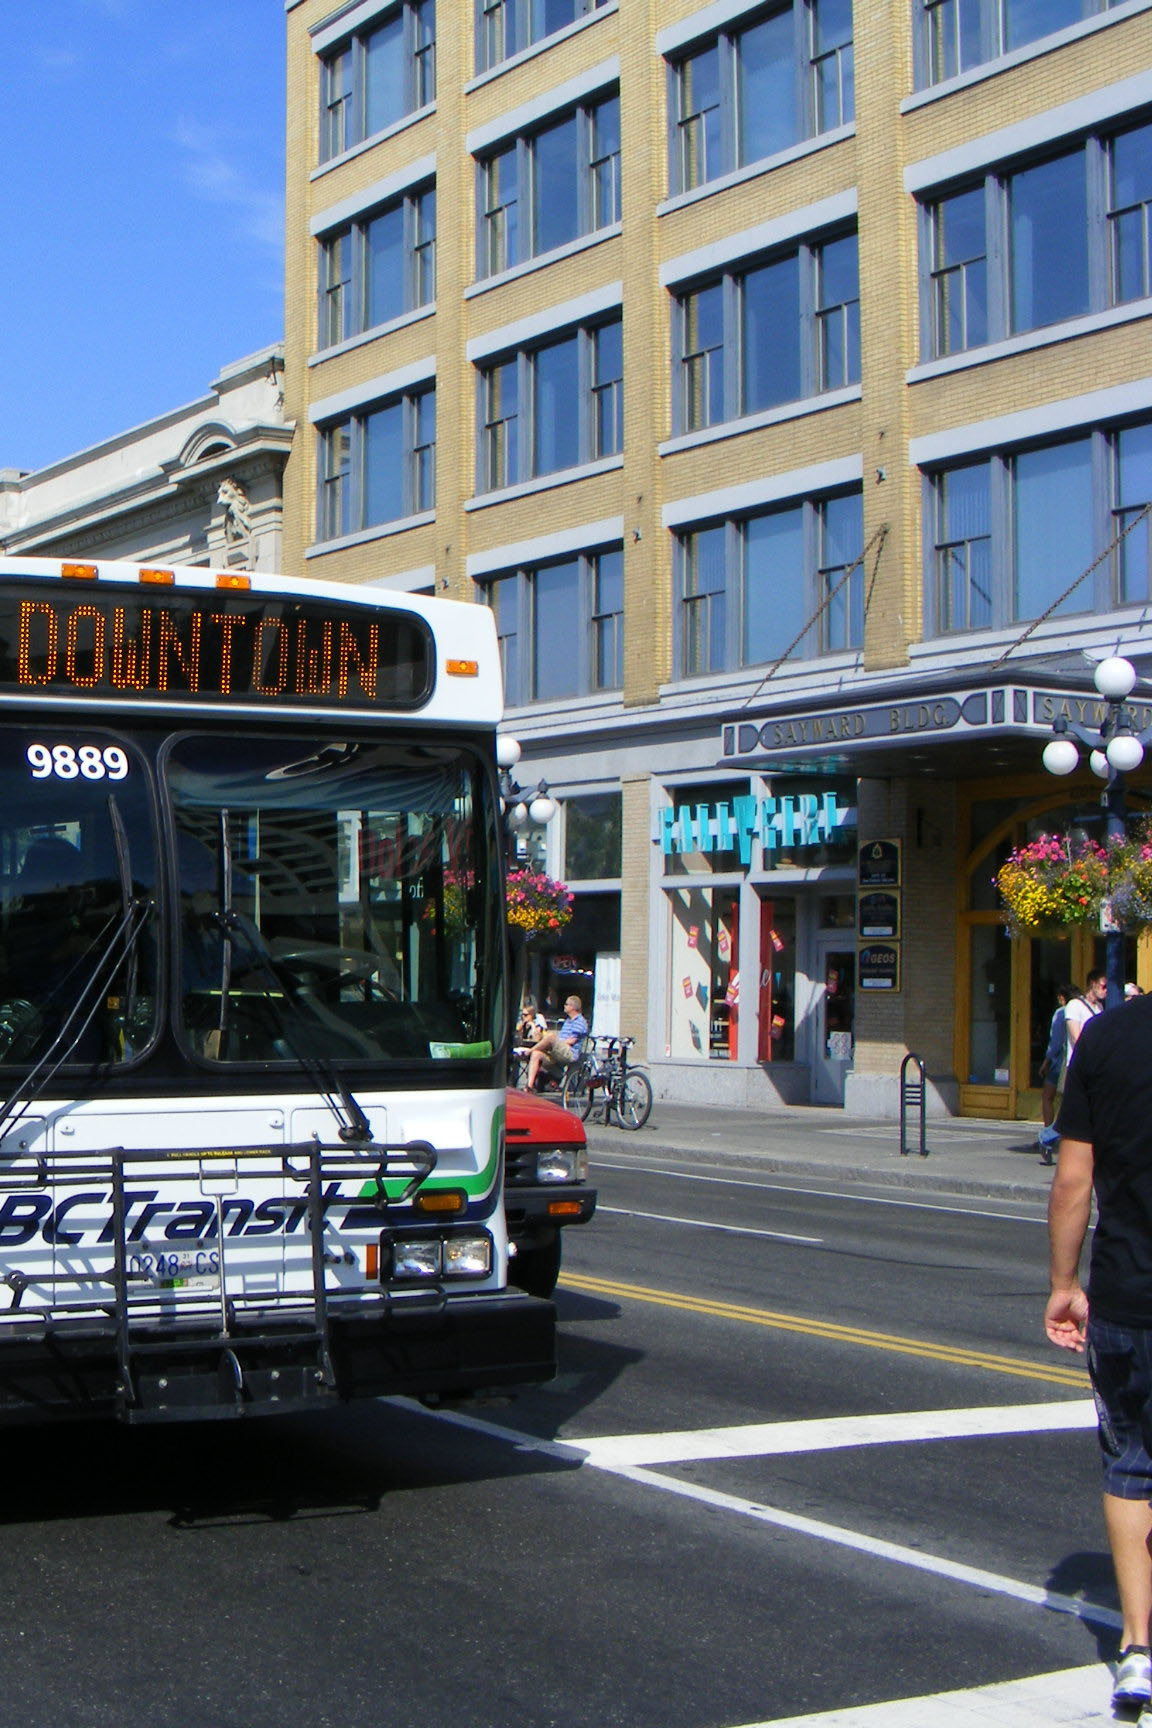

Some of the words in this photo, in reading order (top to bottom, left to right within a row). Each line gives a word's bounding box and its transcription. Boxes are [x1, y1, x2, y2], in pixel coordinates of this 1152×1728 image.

[18, 599, 380, 699] DOWNTOWN
[772, 712, 867, 746] SAYWARD
[26, 743, 130, 781] 9889
[869, 952, 896, 965] GEOS
[129, 1253, 179, 1279] 0248
[195, 1251, 219, 1275] CS
